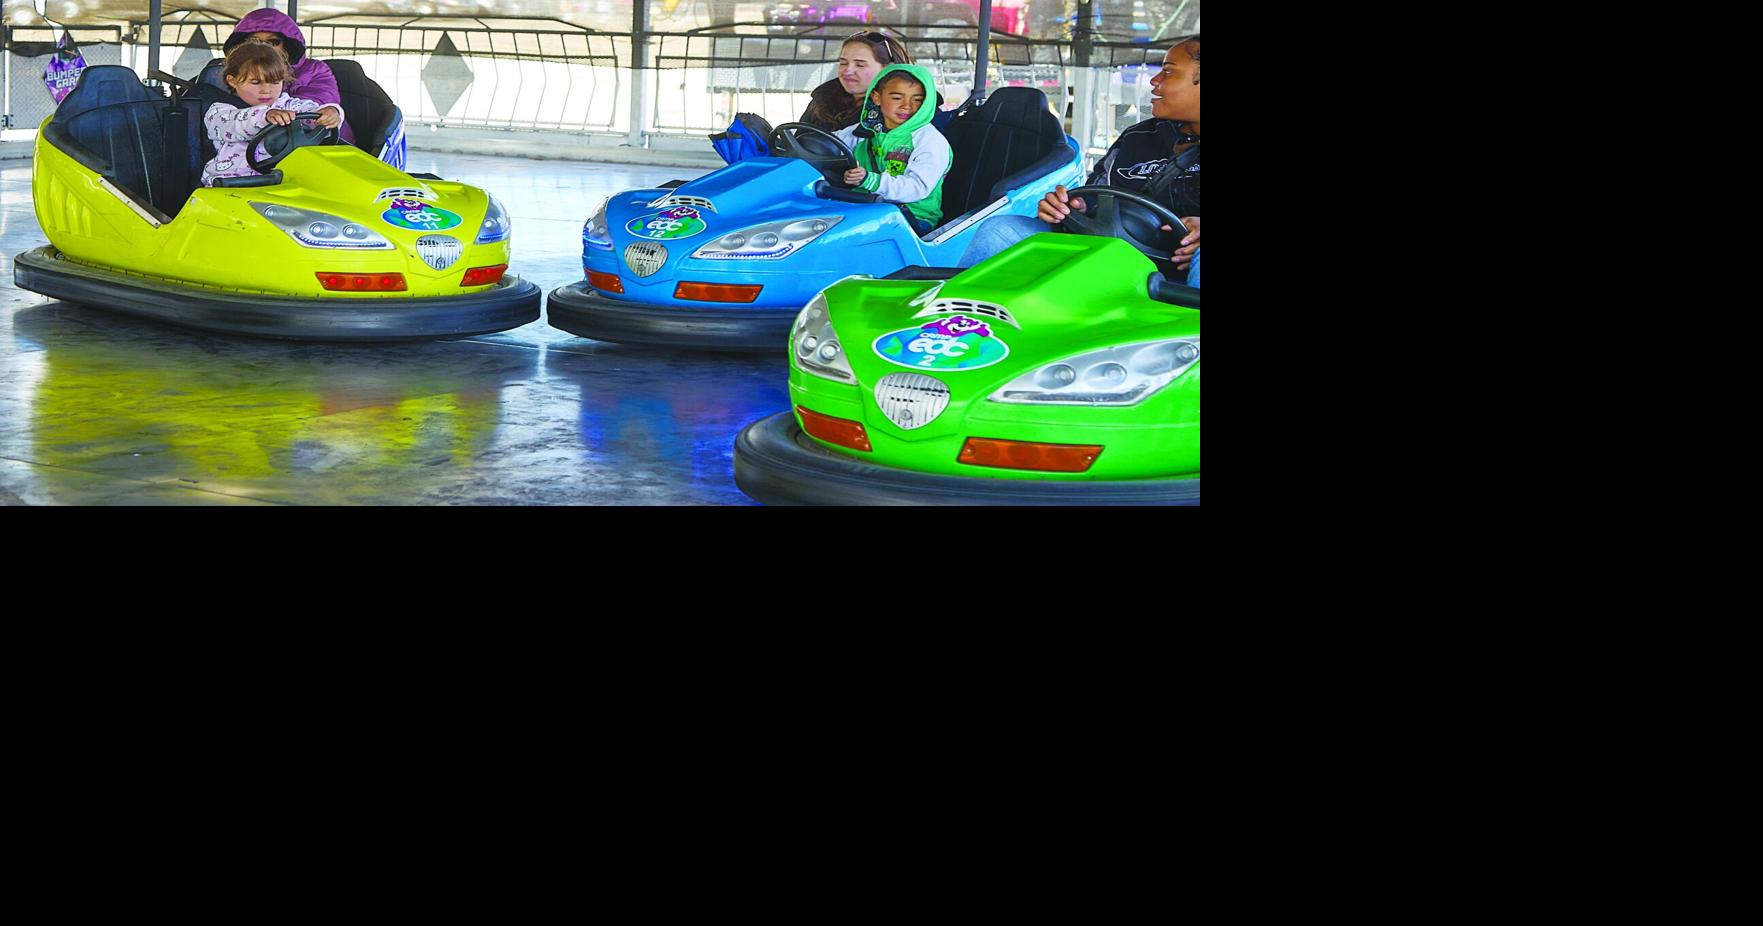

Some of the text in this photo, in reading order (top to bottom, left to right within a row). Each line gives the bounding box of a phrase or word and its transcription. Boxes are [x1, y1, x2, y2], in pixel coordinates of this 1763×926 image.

[47, 68, 84, 81] BUMPE
[648, 230, 665, 238] 12
[918, 355, 936, 366] 2
